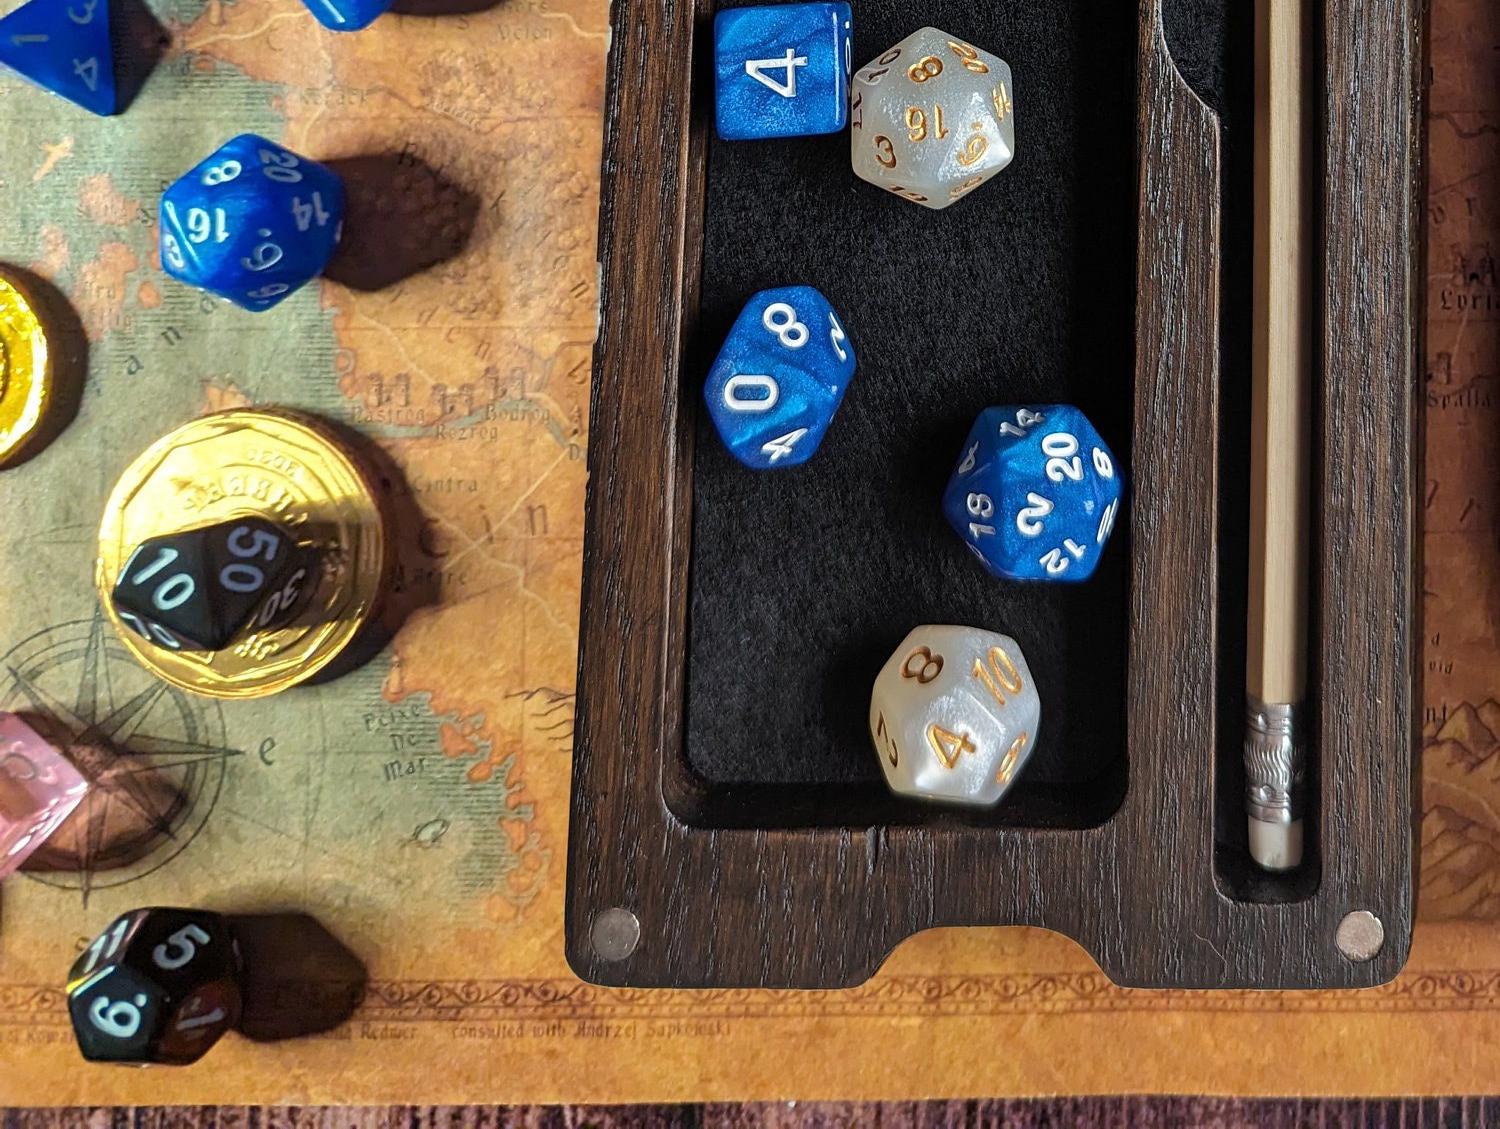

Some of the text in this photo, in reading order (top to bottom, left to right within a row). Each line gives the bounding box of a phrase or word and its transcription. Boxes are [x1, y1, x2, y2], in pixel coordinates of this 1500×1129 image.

[10, 33, 50, 47] 1
[72, 56, 99, 92] 4
[745, 47, 809, 99] 4
[907, 55, 944, 83] 8
[904, 104, 949, 143] 16
[257, 148, 303, 183] 20
[873, 134, 897, 169] 3
[201, 160, 242, 186] 8
[186, 206, 230, 244] 16
[291, 190, 330, 232] 14
[762, 302, 811, 348] 8
[723, 374, 780, 412] 0
[999, 408, 1045, 438] 14
[760, 427, 809, 462] 4
[1041, 431, 1084, 482] 20
[1092, 446, 1114, 479] 8
[412, 478, 478, 493] Cintra
[966, 491, 996, 542] 18
[1016, 491, 1054, 536] 2
[219, 525, 280, 593] 50
[1039, 537, 1087, 573] 12
[132, 547, 196, 611] 10
[259, 569, 306, 627] 30
[901, 645, 944, 685] 8
[972, 645, 1023, 707] 10
[258, 736, 277, 766] e
[926, 723, 977, 770] 4
[385, 756, 427, 782] Mar
[152, 922, 212, 970] 5
[452, 1020, 524, 1040] consulted
[532, 1020, 567, 1039] with
[576, 1020, 638, 1041] Andrzej
